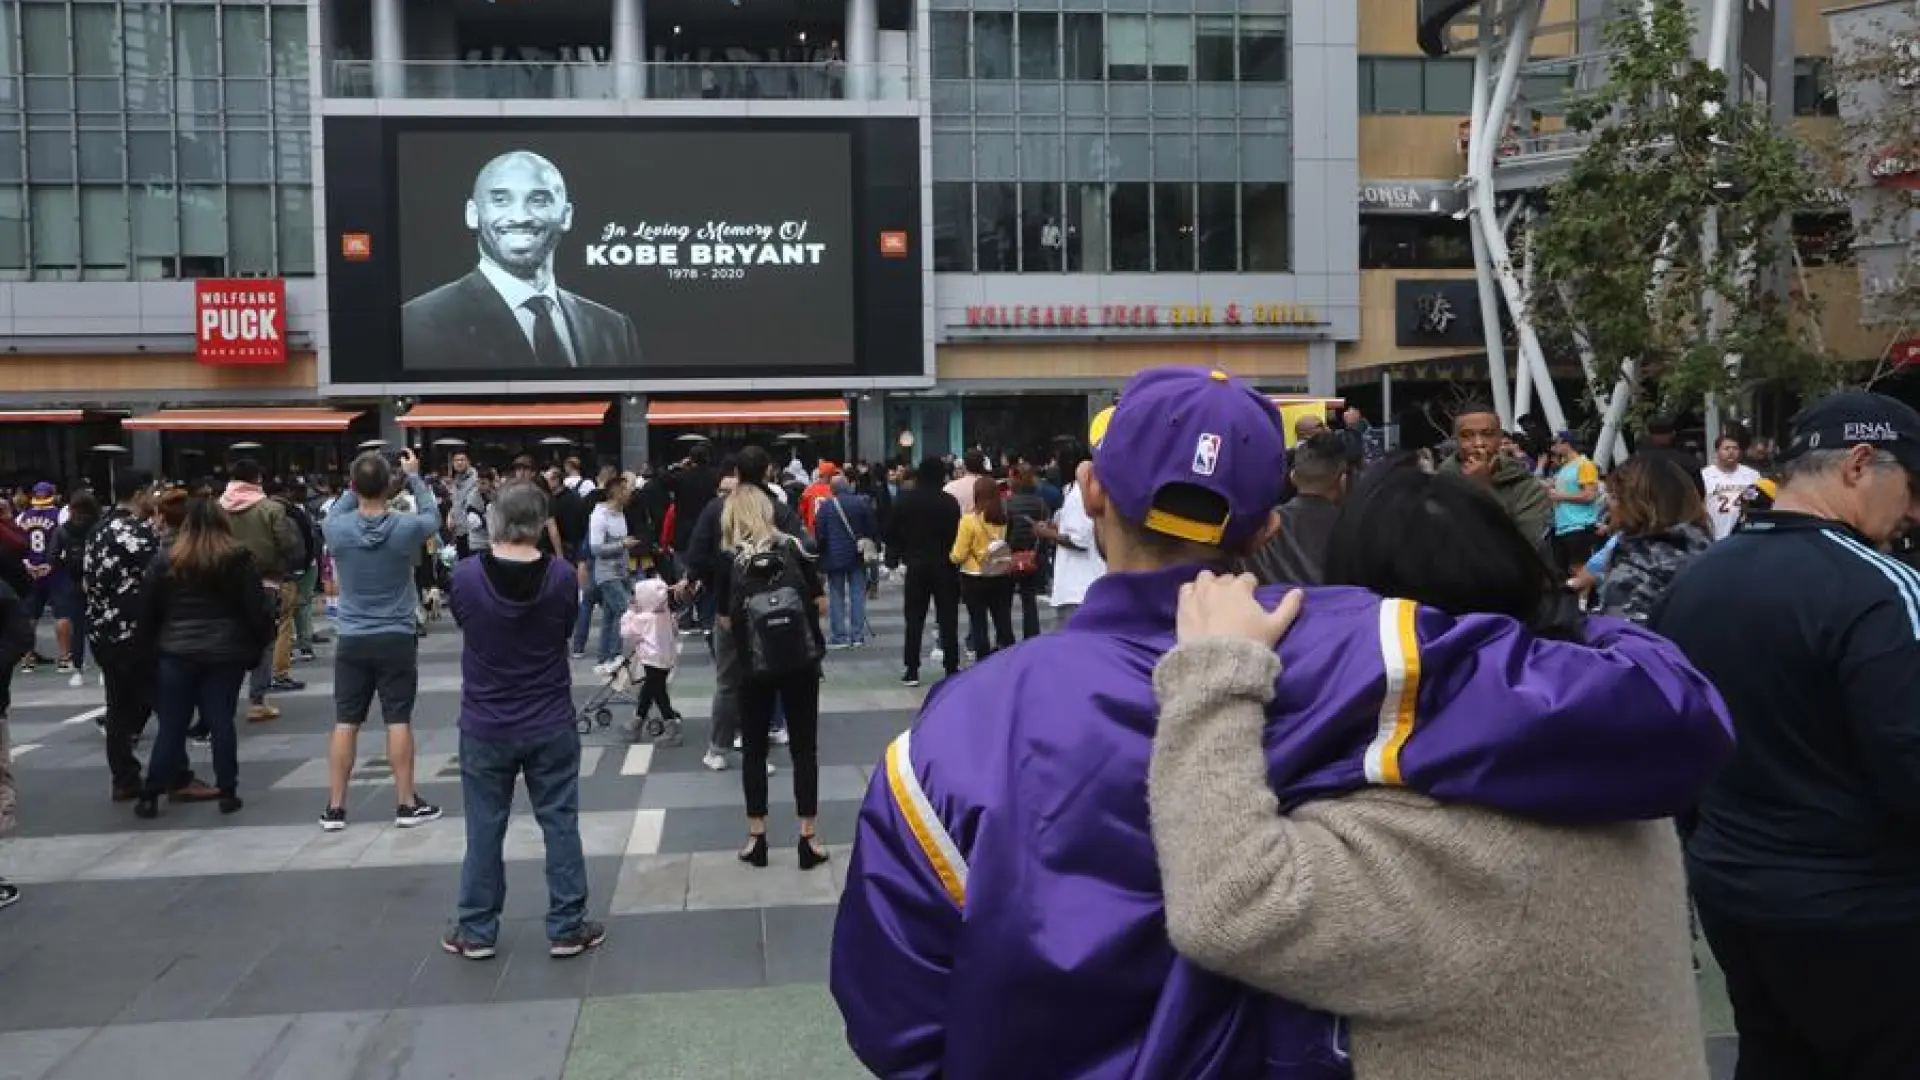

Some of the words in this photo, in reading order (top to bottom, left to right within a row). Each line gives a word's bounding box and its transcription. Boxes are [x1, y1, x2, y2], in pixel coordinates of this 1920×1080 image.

[601, 221, 627, 241] In
[633, 220, 690, 241] Loving
[697, 220, 773, 243] Memory
[780, 220, 808, 240] Of
[586, 244, 679, 266] KOBE
[690, 243, 826, 265] BRYANT
[668, 268, 698, 279] 1978
[711, 268, 745, 279] 2020
[201, 292, 276, 304] WOLFGANG
[202, 308, 279, 341] PUCK
[967, 304, 1089, 327] WOLFGANG
[1103, 304, 1158, 327] PUCK
[1171, 304, 1213, 327] BAR
[1225, 302, 1242, 325] &
[1843, 421, 1896, 434] FINAL
[1717, 494, 1744, 513] 24
[30, 530, 46, 553] 8
